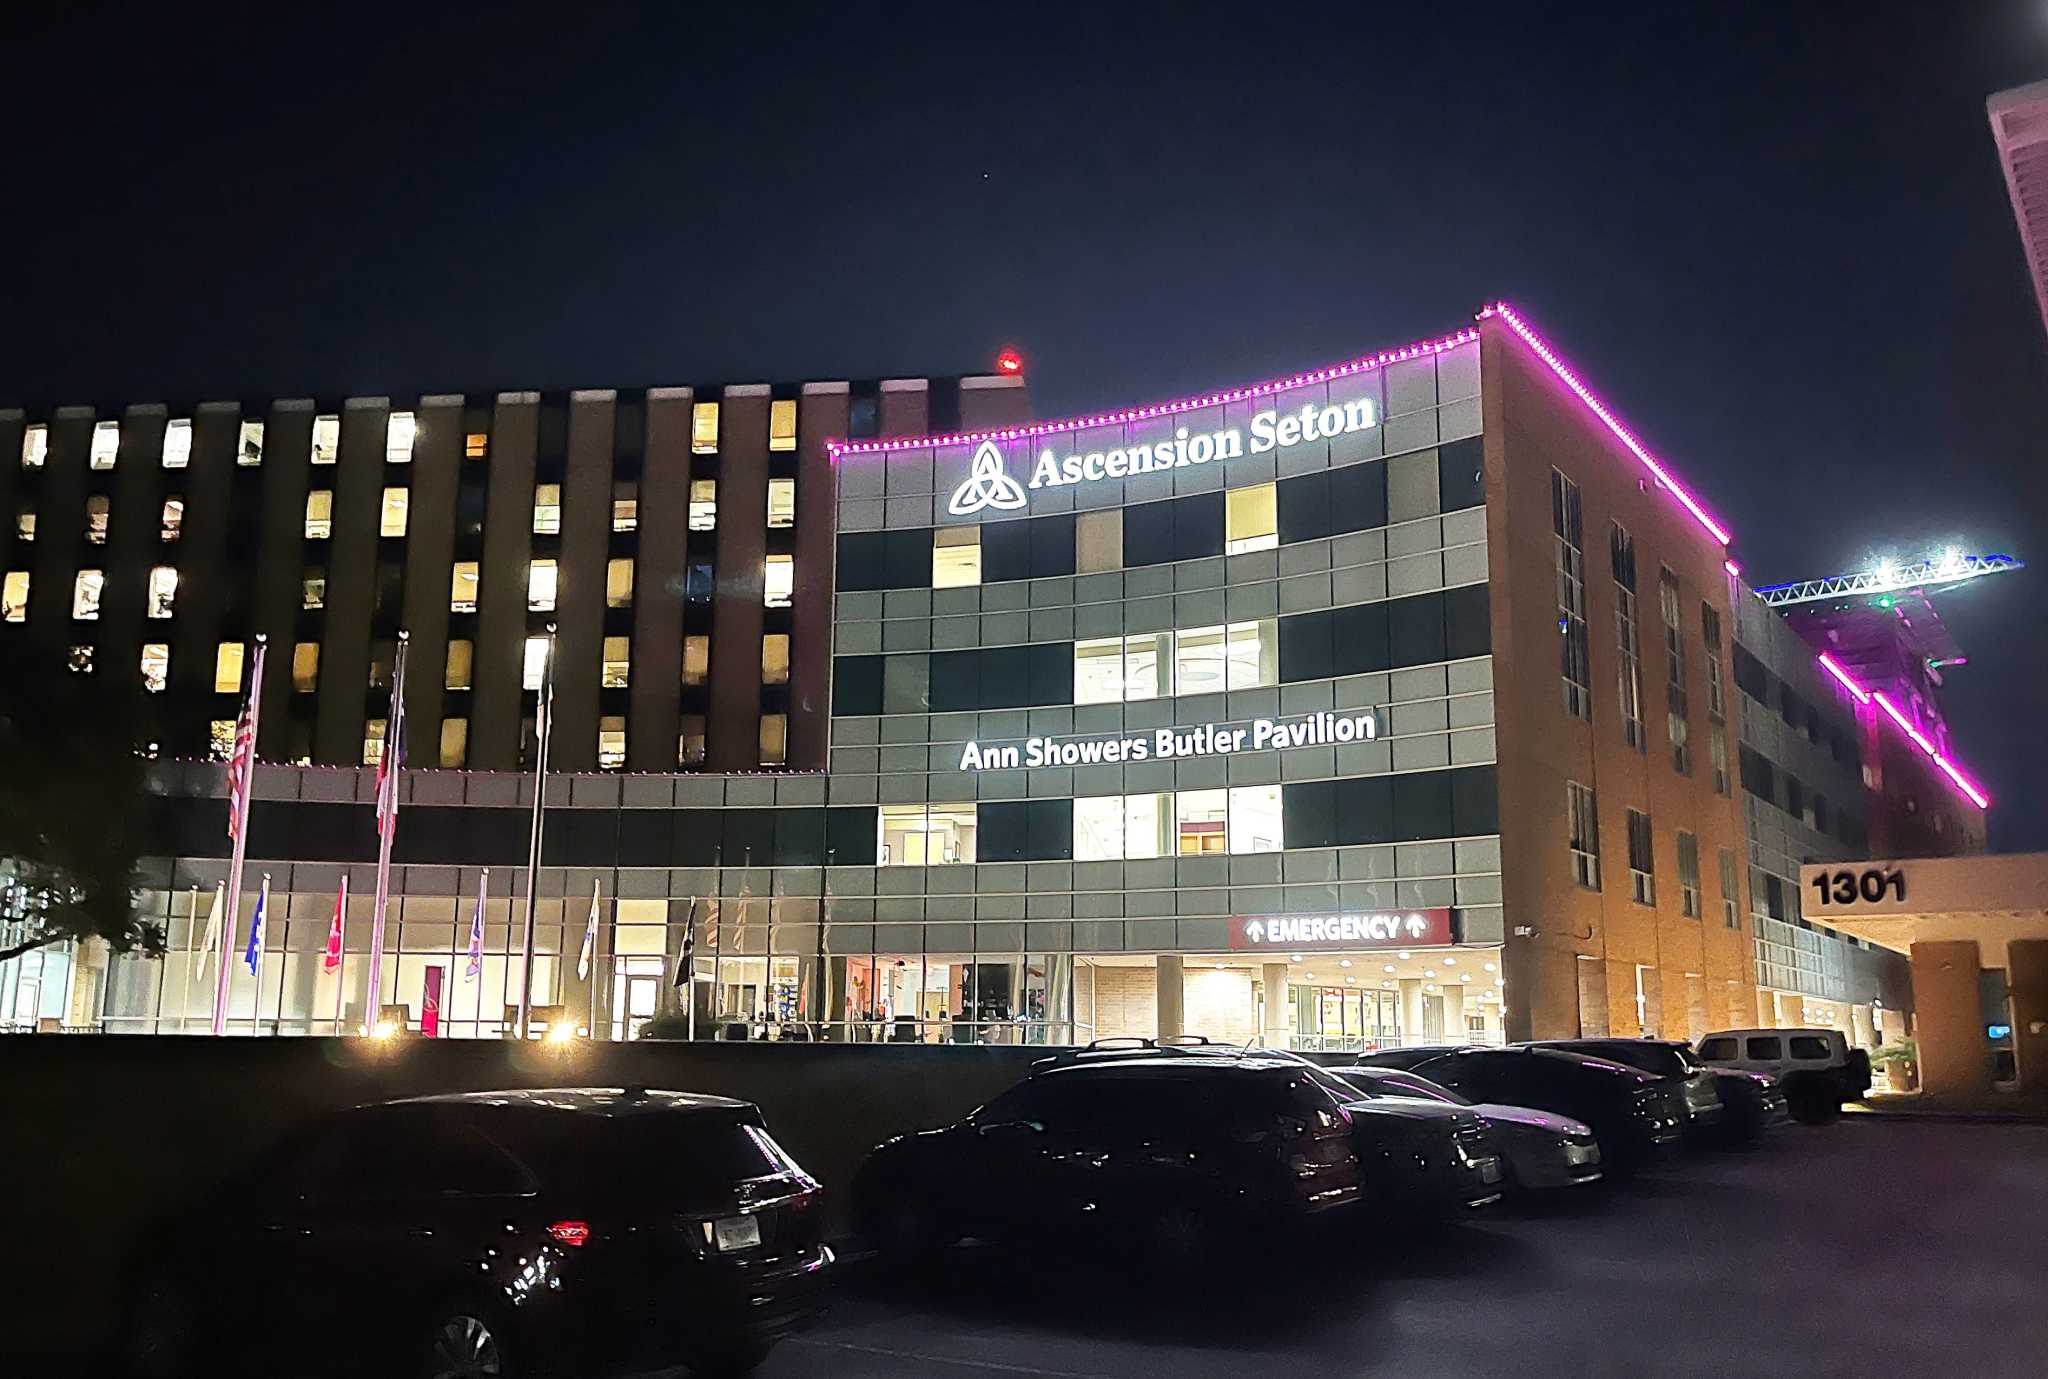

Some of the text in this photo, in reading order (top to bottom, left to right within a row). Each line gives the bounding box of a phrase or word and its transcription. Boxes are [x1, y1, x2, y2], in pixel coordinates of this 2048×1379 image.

[1030, 400, 1376, 488] Ascension Seton
[960, 711, 1375, 770] Ann Showers Butler Pavilion
[1812, 868, 1906, 905] 1301
[1267, 915, 1401, 942] EMERGENCY
